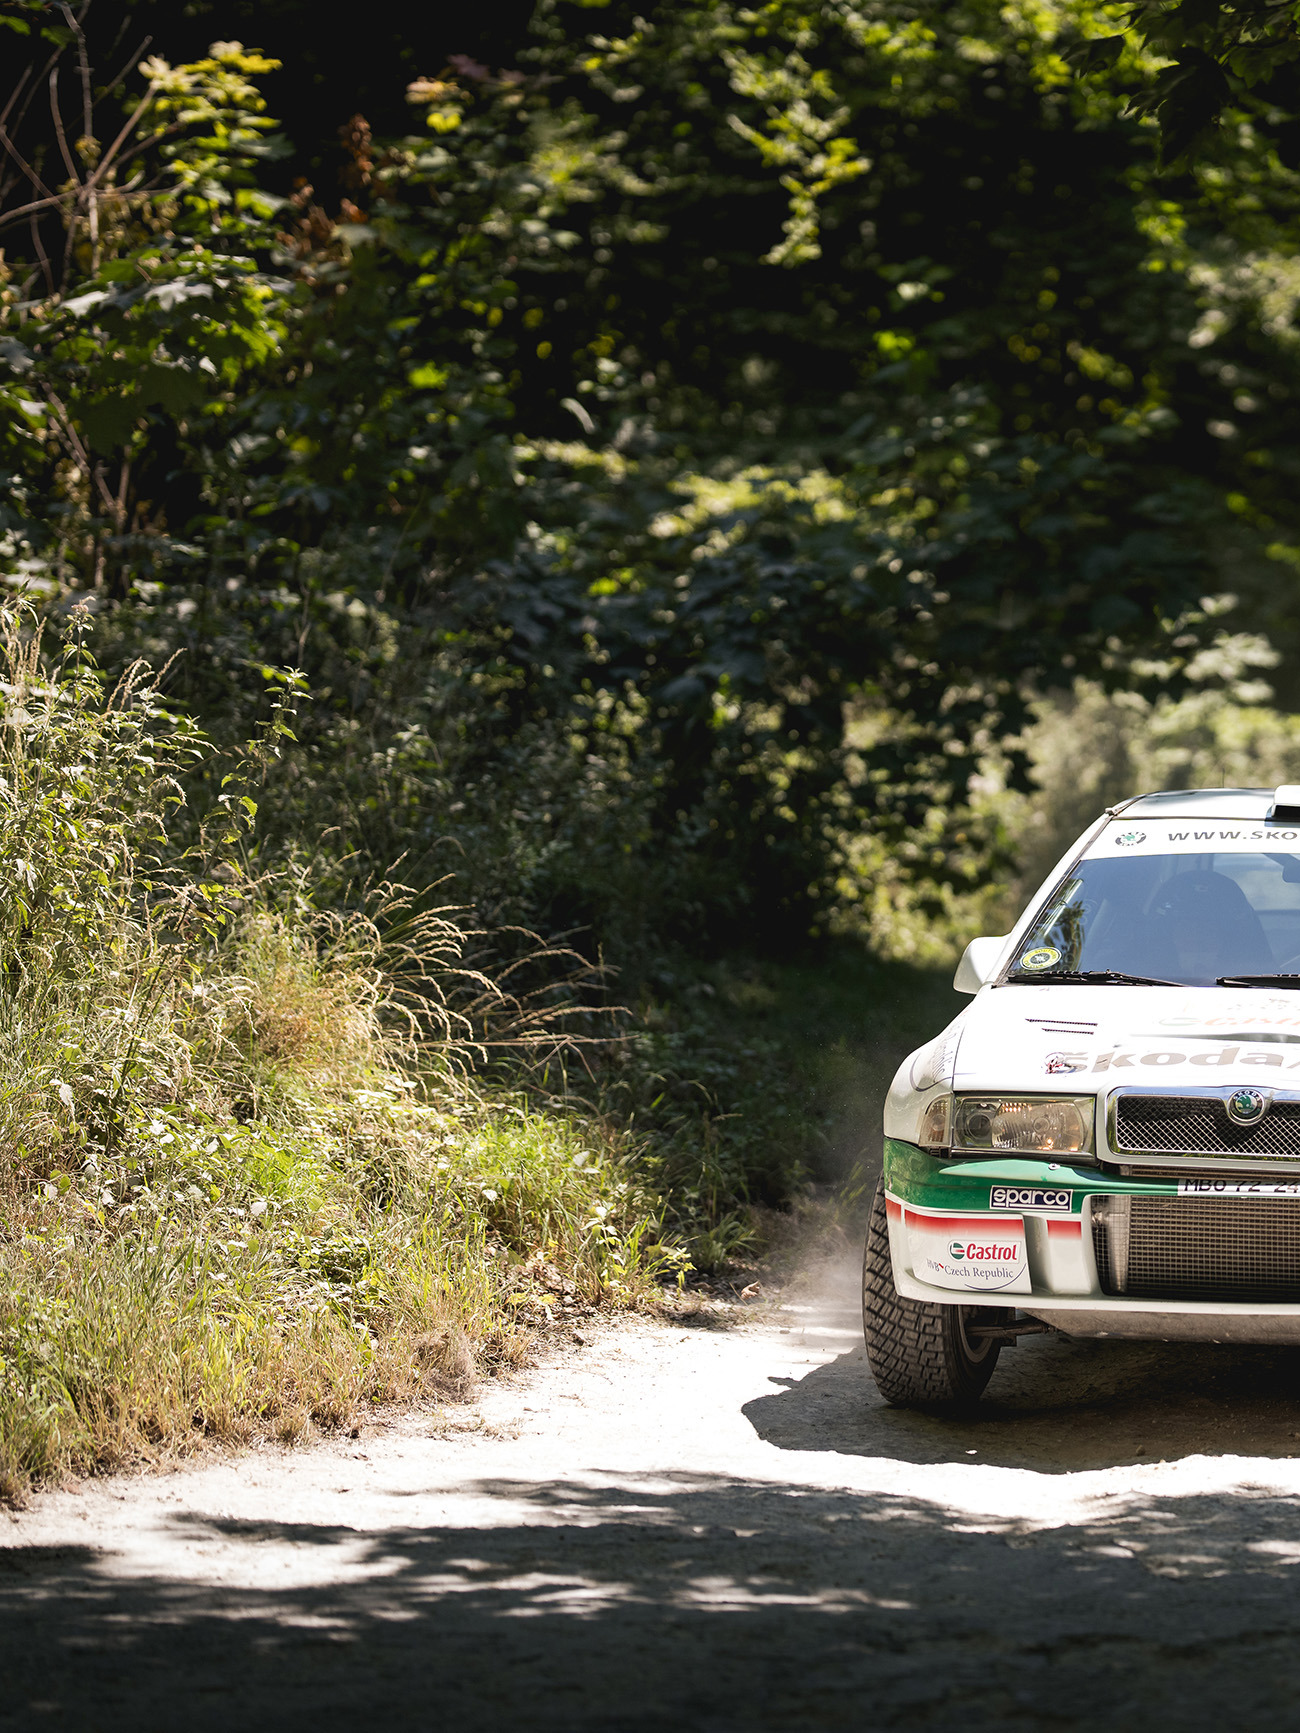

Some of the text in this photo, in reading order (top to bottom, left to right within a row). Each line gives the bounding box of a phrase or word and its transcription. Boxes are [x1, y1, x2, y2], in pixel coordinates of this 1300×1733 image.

[993, 1188, 1070, 1208] sparco
[966, 1242, 1018, 1261] Castrol
[944, 1264, 971, 1278] Czech
[972, 1266, 1014, 1281] Republic
